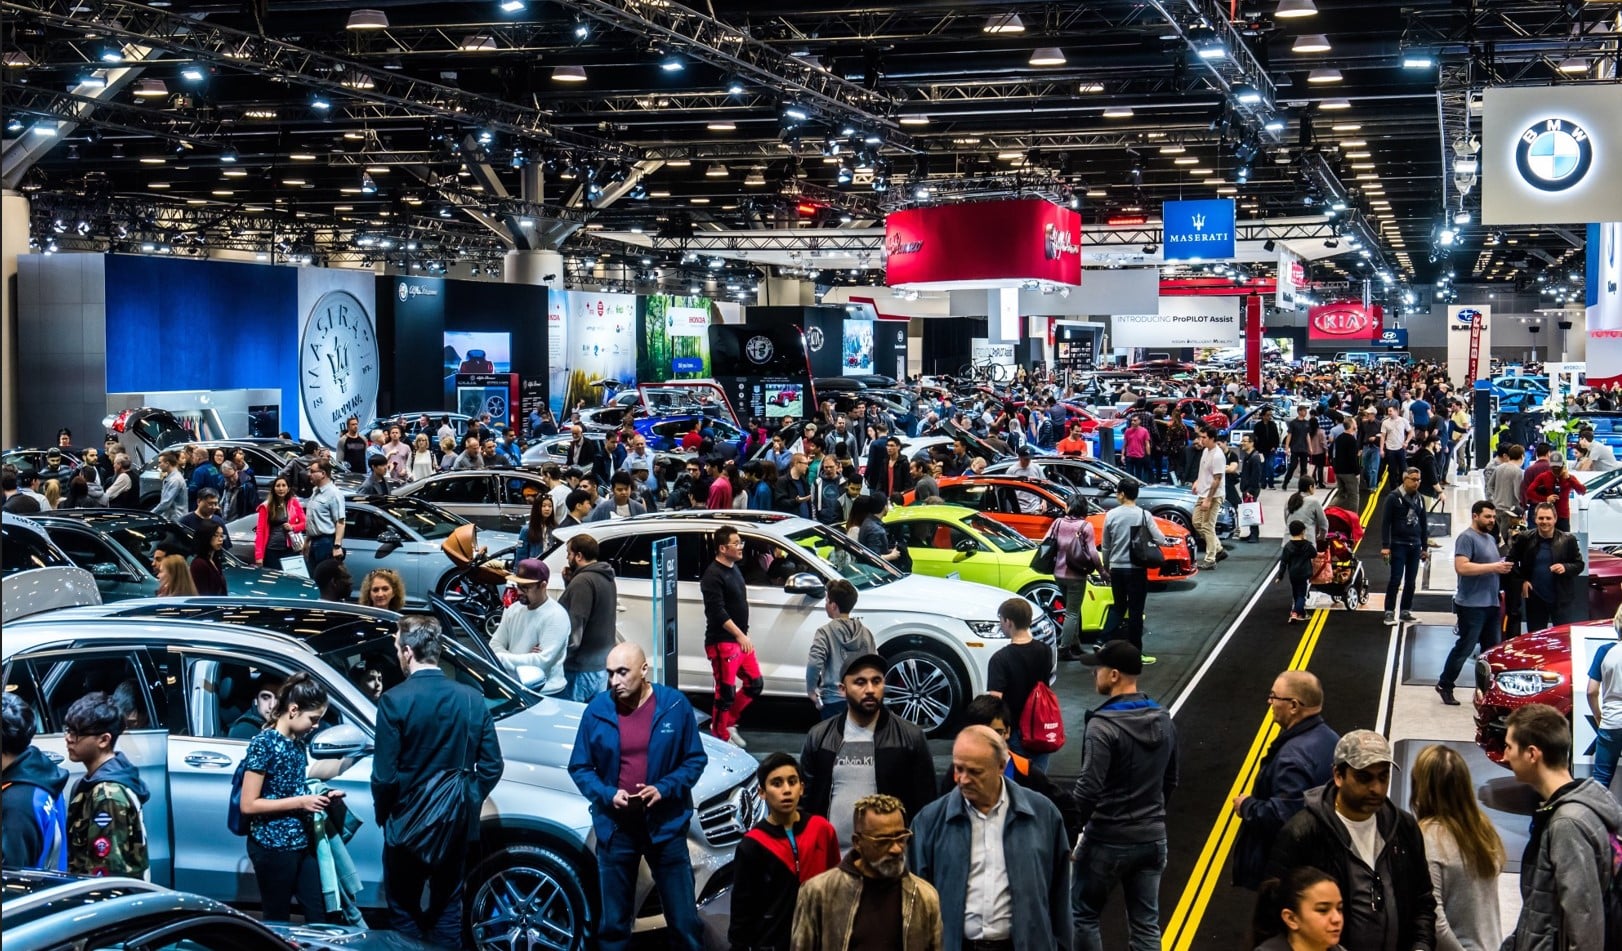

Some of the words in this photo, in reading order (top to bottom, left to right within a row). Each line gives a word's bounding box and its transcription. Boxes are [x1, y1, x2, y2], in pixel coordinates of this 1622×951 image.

[1522, 119, 1587, 145] BMW
[1169, 232, 1229, 243] MASERATI
[688, 316, 706, 324] HONDA
[1117, 315, 1171, 323] INTRODUCING
[1172, 315, 1208, 323] ProPILOT
[1209, 315, 1233, 323] Assist
[1323, 314, 1360, 330] KIA
[1470, 316, 1480, 359] BEER
